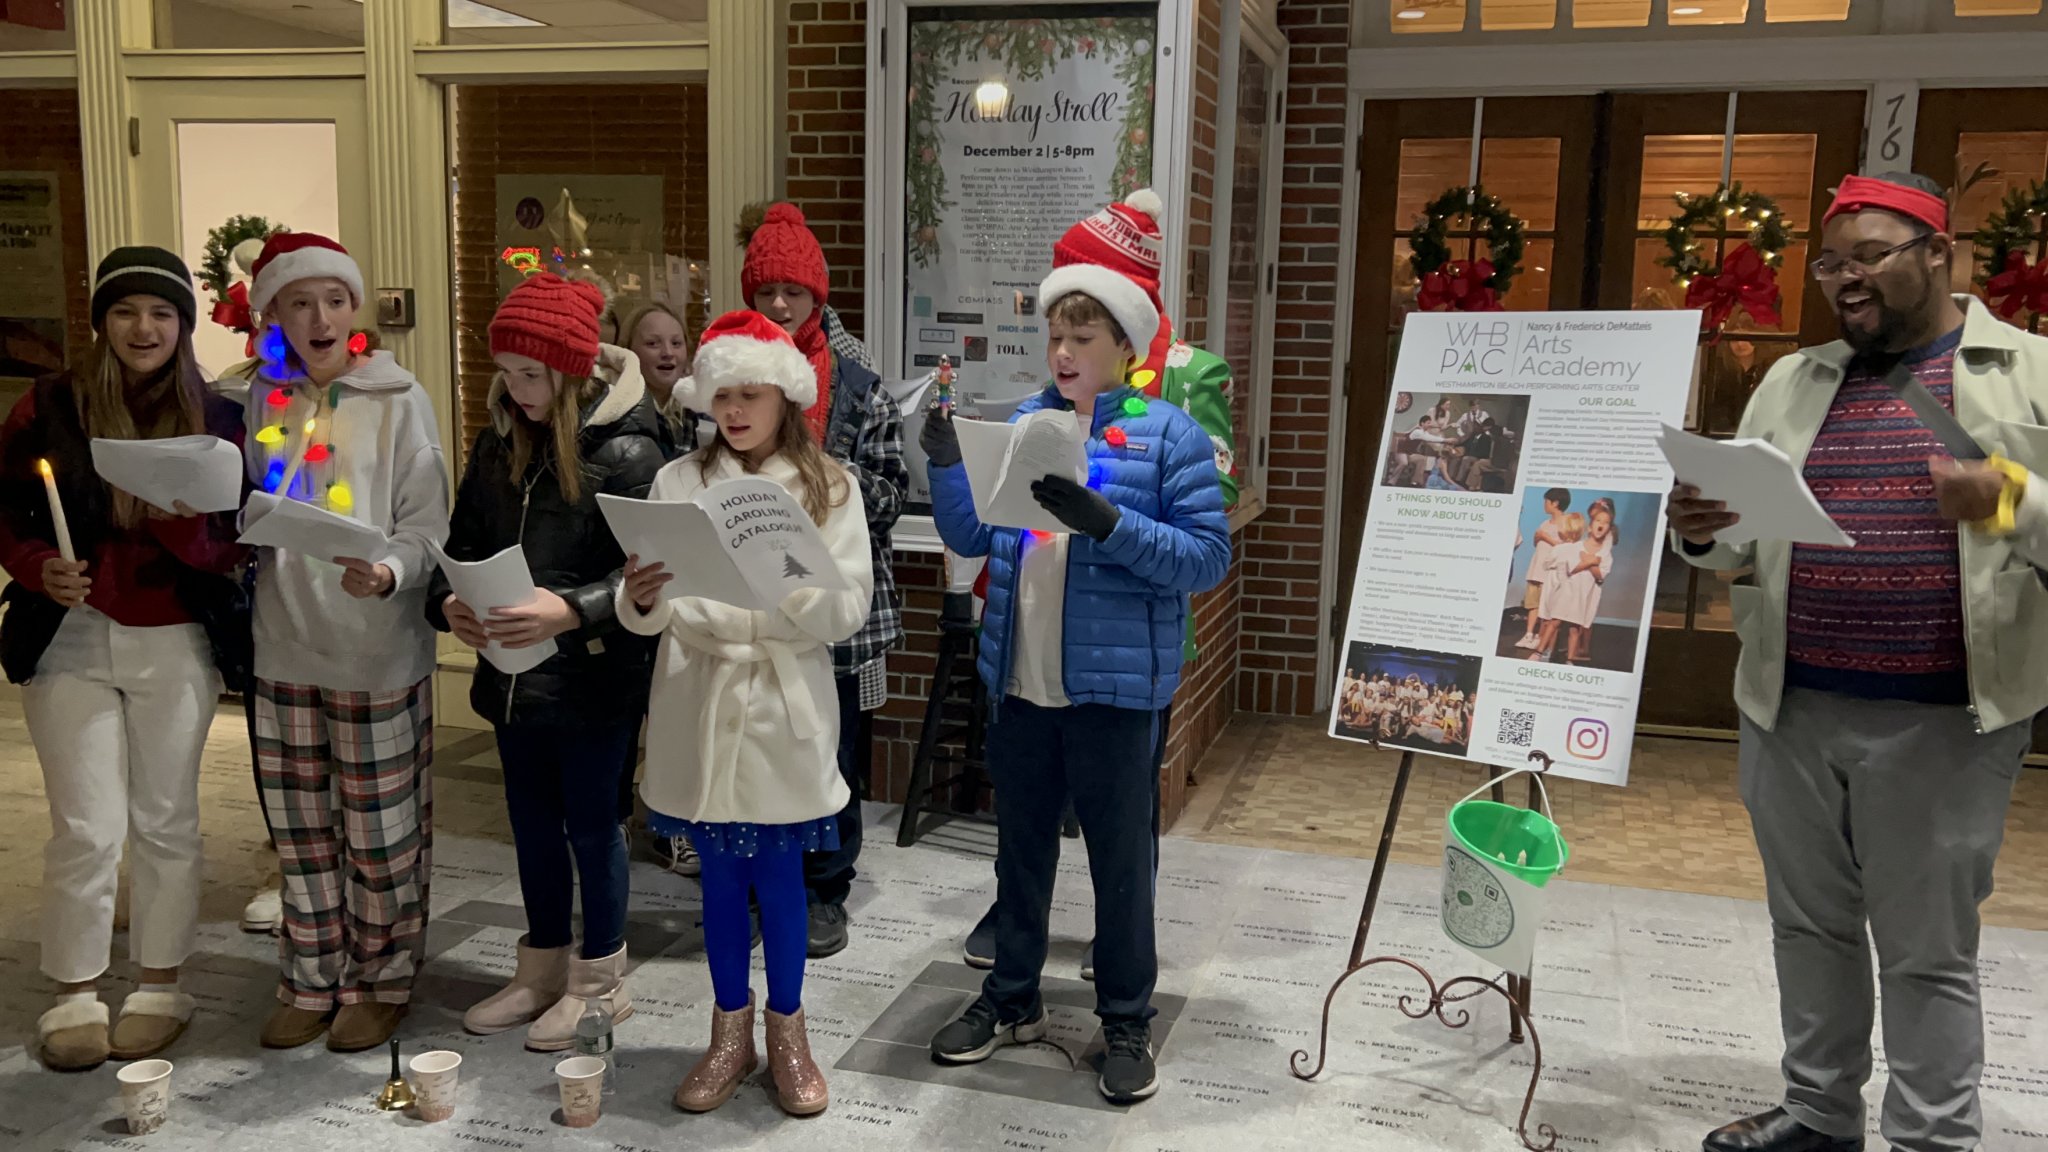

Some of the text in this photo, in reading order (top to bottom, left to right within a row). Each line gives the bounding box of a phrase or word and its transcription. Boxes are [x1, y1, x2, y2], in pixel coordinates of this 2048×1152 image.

[1045, 90, 1118, 124] Stroll
[963, 145, 1033, 157] December
[1035, 146, 1043, 157] 2
[1052, 145, 1095, 159] 5-8pm
[1108, 217, 1143, 242] TUBA
[991, 280, 1030, 288] Participating
[1526, 321, 1652, 333] Nancy & Frederick DeMatteis
[1522, 335, 1573, 354] Arts
[1440, 348, 1506, 375] PAC
[1518, 356, 1642, 383] Academy
[1434, 380, 1640, 392] WESTHAMPTON BEACH PERFORMING ARTS CENTER
[1578, 397, 1637, 407] OUR GOAL
[720, 493, 778, 511] HOLIDAY
[1386, 493, 1503, 509] 5 THINGS YOU SHOULD
[725, 508, 791, 530] CAROLING
[1397, 508, 1485, 522] KNOW ABOUT US
[1517, 666, 1605, 687] CHECK US OUT!
[1179, 1077, 1271, 1096] WESTHAMPTON
[1194, 1092, 1242, 1105] ROTARY
[1000, 1122, 1023, 1134] THE
[1357, 1117, 1403, 1129] FAMILY
